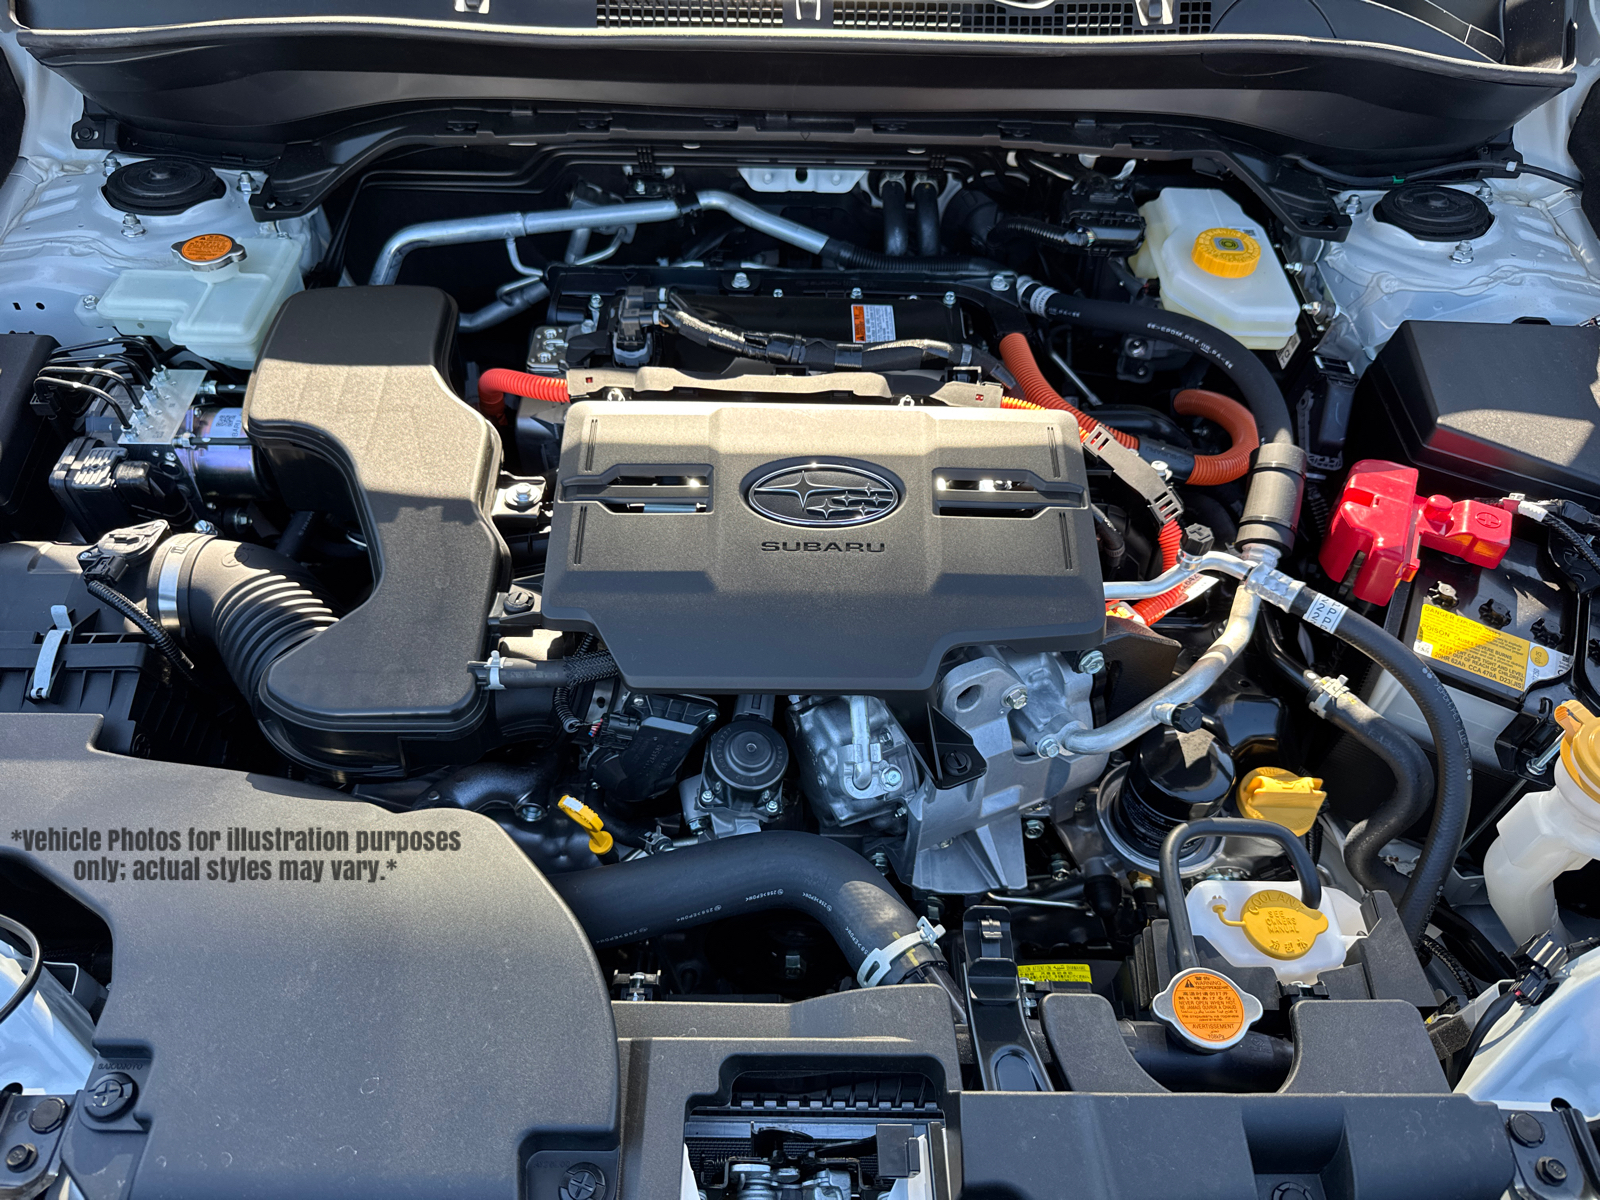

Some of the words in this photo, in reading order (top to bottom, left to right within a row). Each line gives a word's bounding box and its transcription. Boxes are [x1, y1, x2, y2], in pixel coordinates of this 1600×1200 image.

[761, 541, 885, 552] SUBARU
[1424, 605, 1455, 620] DANGER
[1421, 623, 1450, 638] POISON
[1454, 635, 1474, 646] CAUSES
[1494, 650, 1513, 661] BURNS
[1434, 651, 1450, 662] 20HR
[1450, 657, 1466, 668] 62Ah
[1468, 664, 1482, 674] CCA
[1482, 669, 1497, 680] 470A
[1454, 648, 1467, 656] VENT
[1467, 653, 1481, 661] CAPS
[1482, 658, 1497, 667] TIGHT
[1509, 668, 1525, 679] LEVEL
[1472, 659, 1490, 670] REACH
[1498, 669, 1524, 682] CHILDREN
[1248, 891, 1304, 915] COOLANT
[1267, 910, 1284, 919] SEE
[1267, 926, 1299, 934] MANUAL
